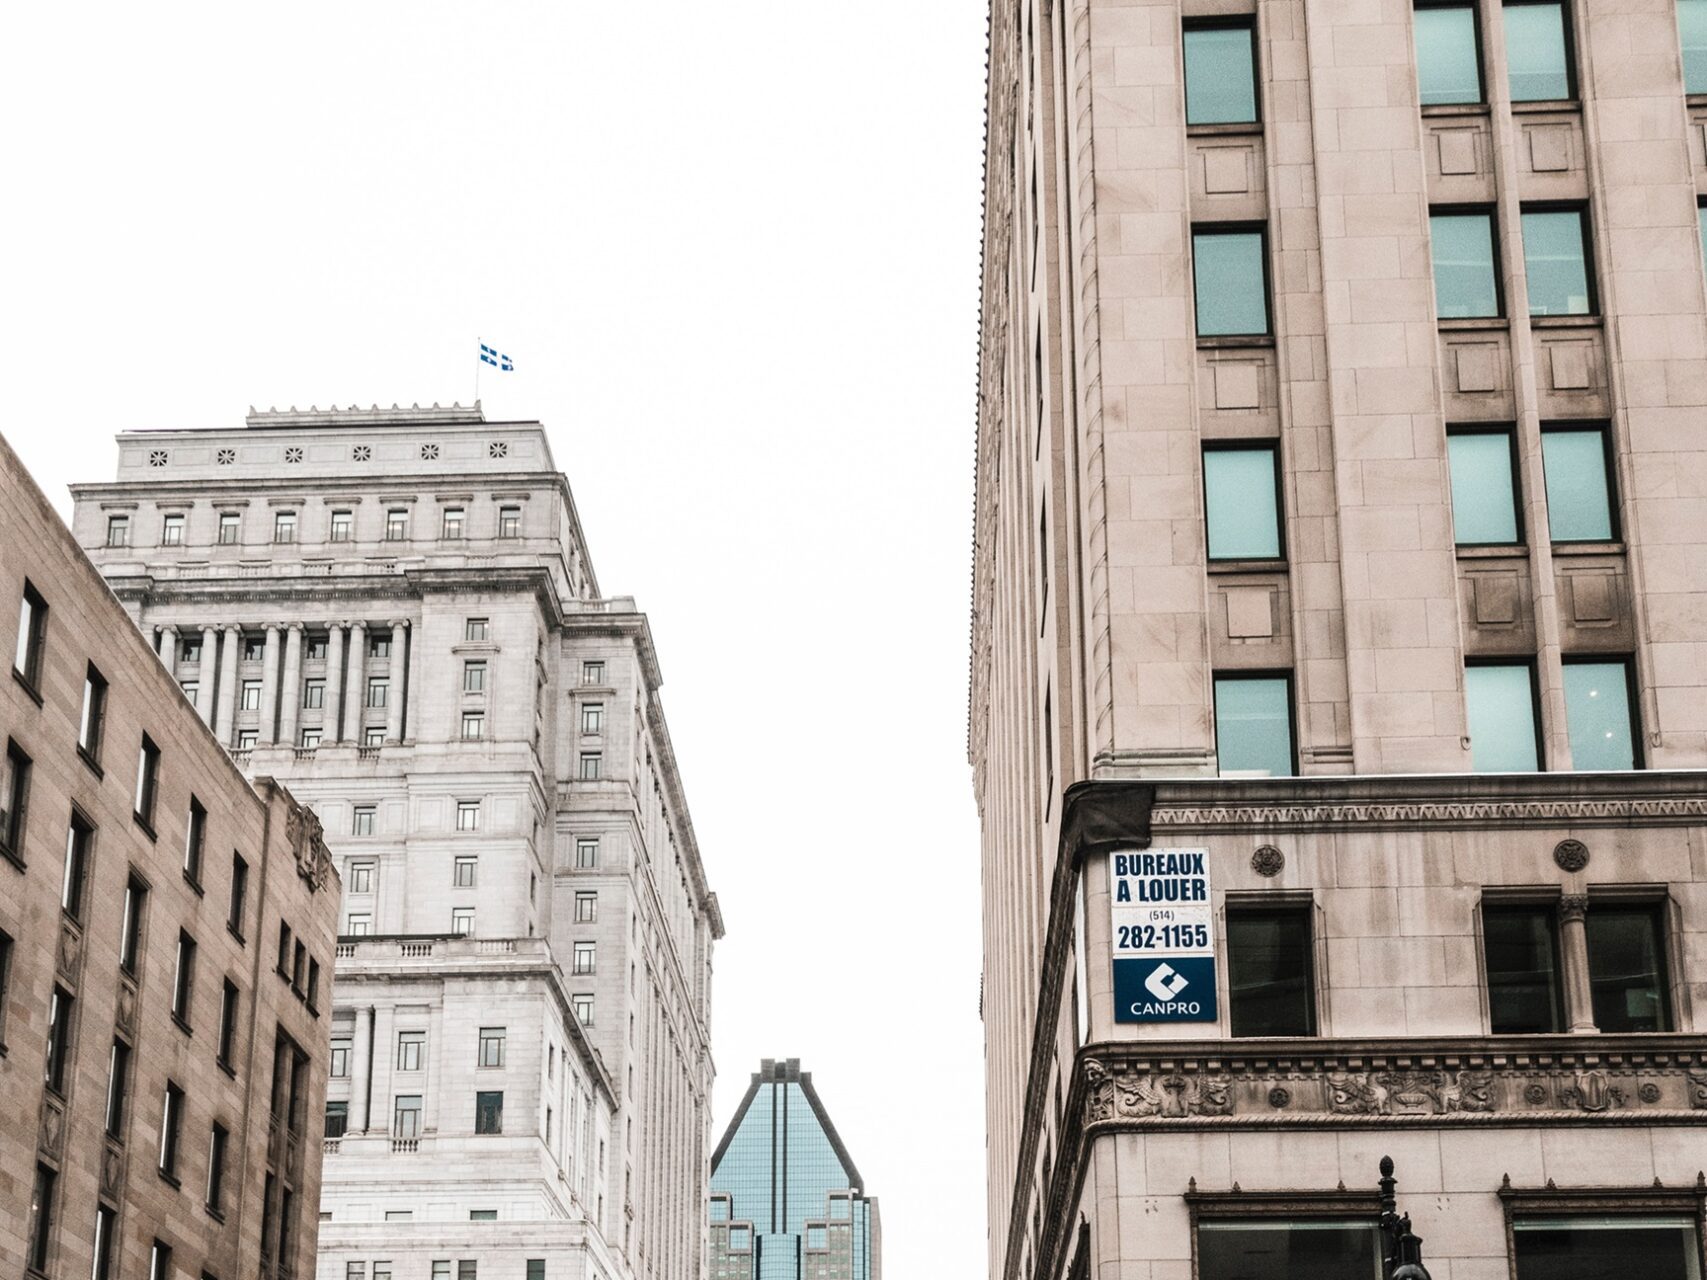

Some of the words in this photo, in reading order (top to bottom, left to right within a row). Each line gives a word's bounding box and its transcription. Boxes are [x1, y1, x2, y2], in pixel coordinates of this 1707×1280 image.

[1114, 852, 1205, 877] BUREAUX
[1138, 878, 1206, 902] LOUER
[1149, 910, 1175, 922] (514)
[1118, 924, 1208, 949] 282-1155
[1130, 1002, 1201, 1016] CANPRO
